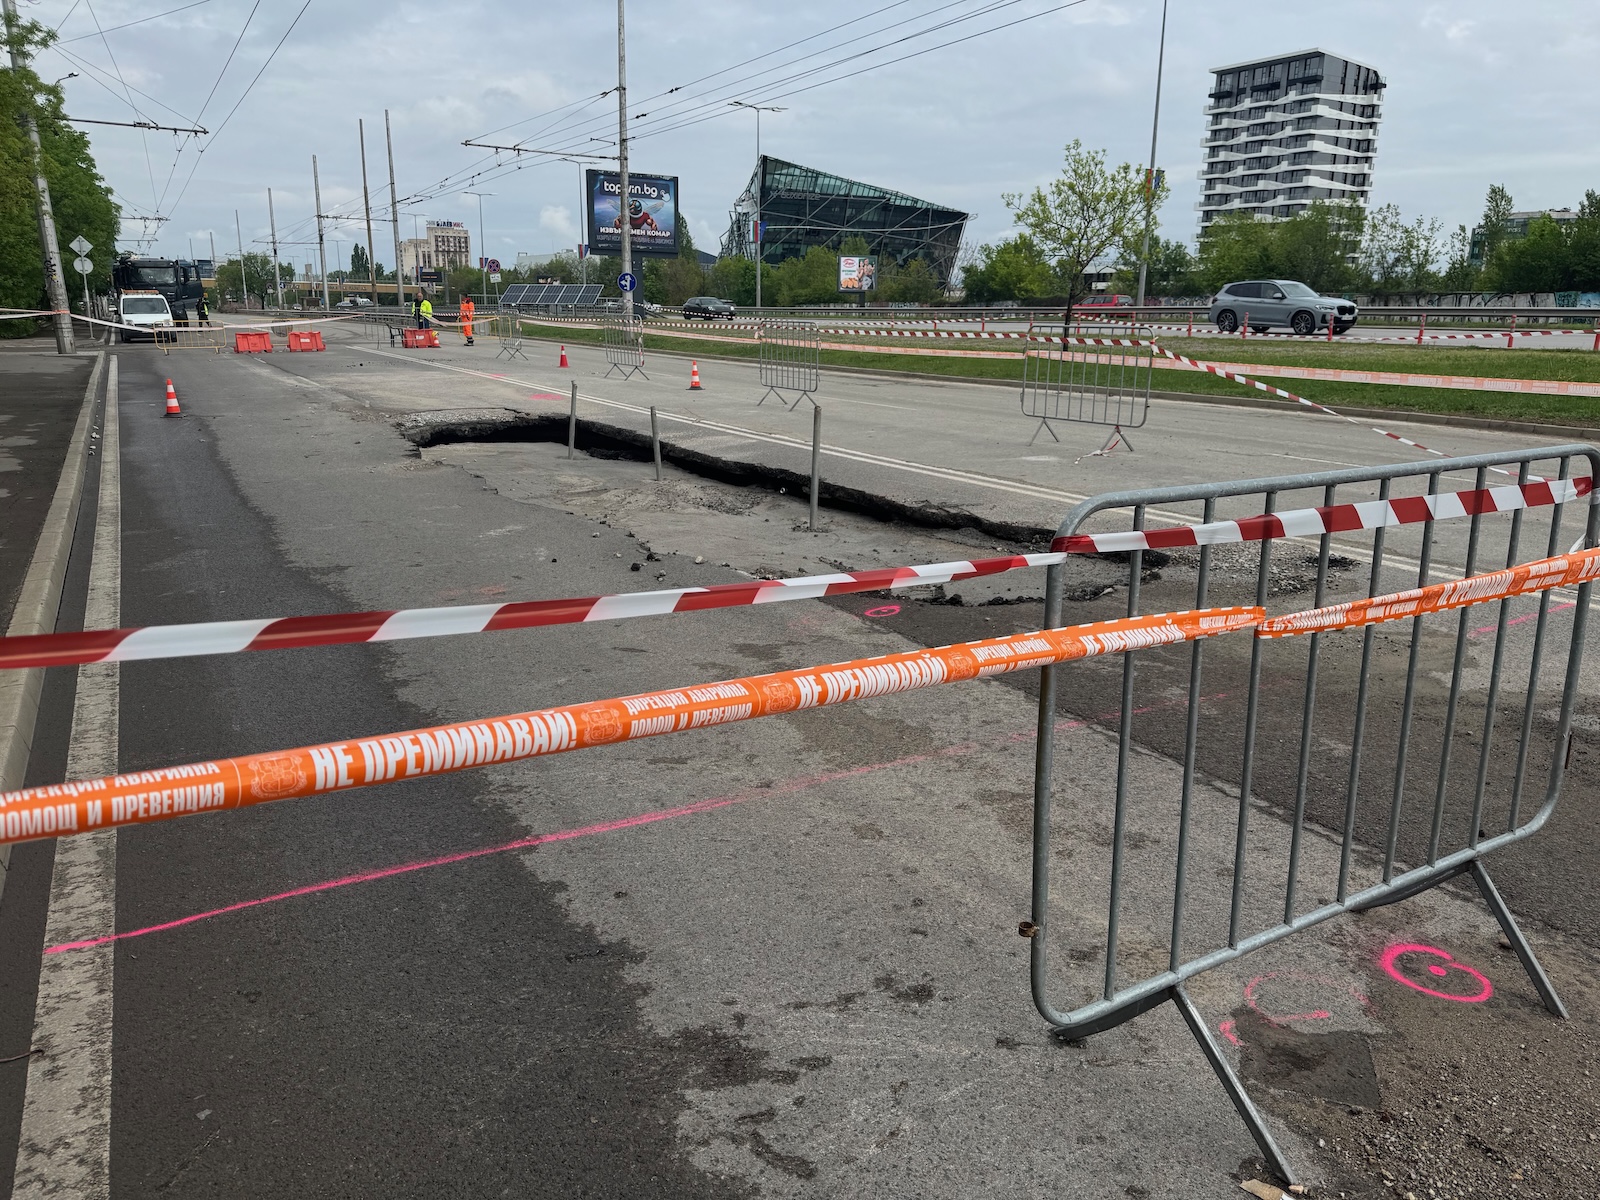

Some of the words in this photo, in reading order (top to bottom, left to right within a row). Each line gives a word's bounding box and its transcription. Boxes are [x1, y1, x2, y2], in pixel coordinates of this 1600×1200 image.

[600, 227, 645, 236] ИЗВЪНМЕН
[647, 229, 671, 237] КОМАР
[1079, 635, 1101, 657] НЕ
[622, 692, 689, 716] ДИРЕКЦИЯ
[687, 683, 749, 703] АВАРИЙНА
[793, 675, 822, 710] НЕ
[820, 653, 948, 705] ПРЕМИНАВАЙ!
[628, 714, 676, 739] ПОМОЩ
[677, 712, 688, 730] И
[690, 702, 753, 728] ПРЕВЕНЦИЯ
[309, 744, 354, 791] НЕ
[358, 710, 578, 782] ПРЕМИНАВАЙ!
[86, 799, 102, 827] И
[111, 782, 225, 822] ПРЕВЕНЦИЯ
